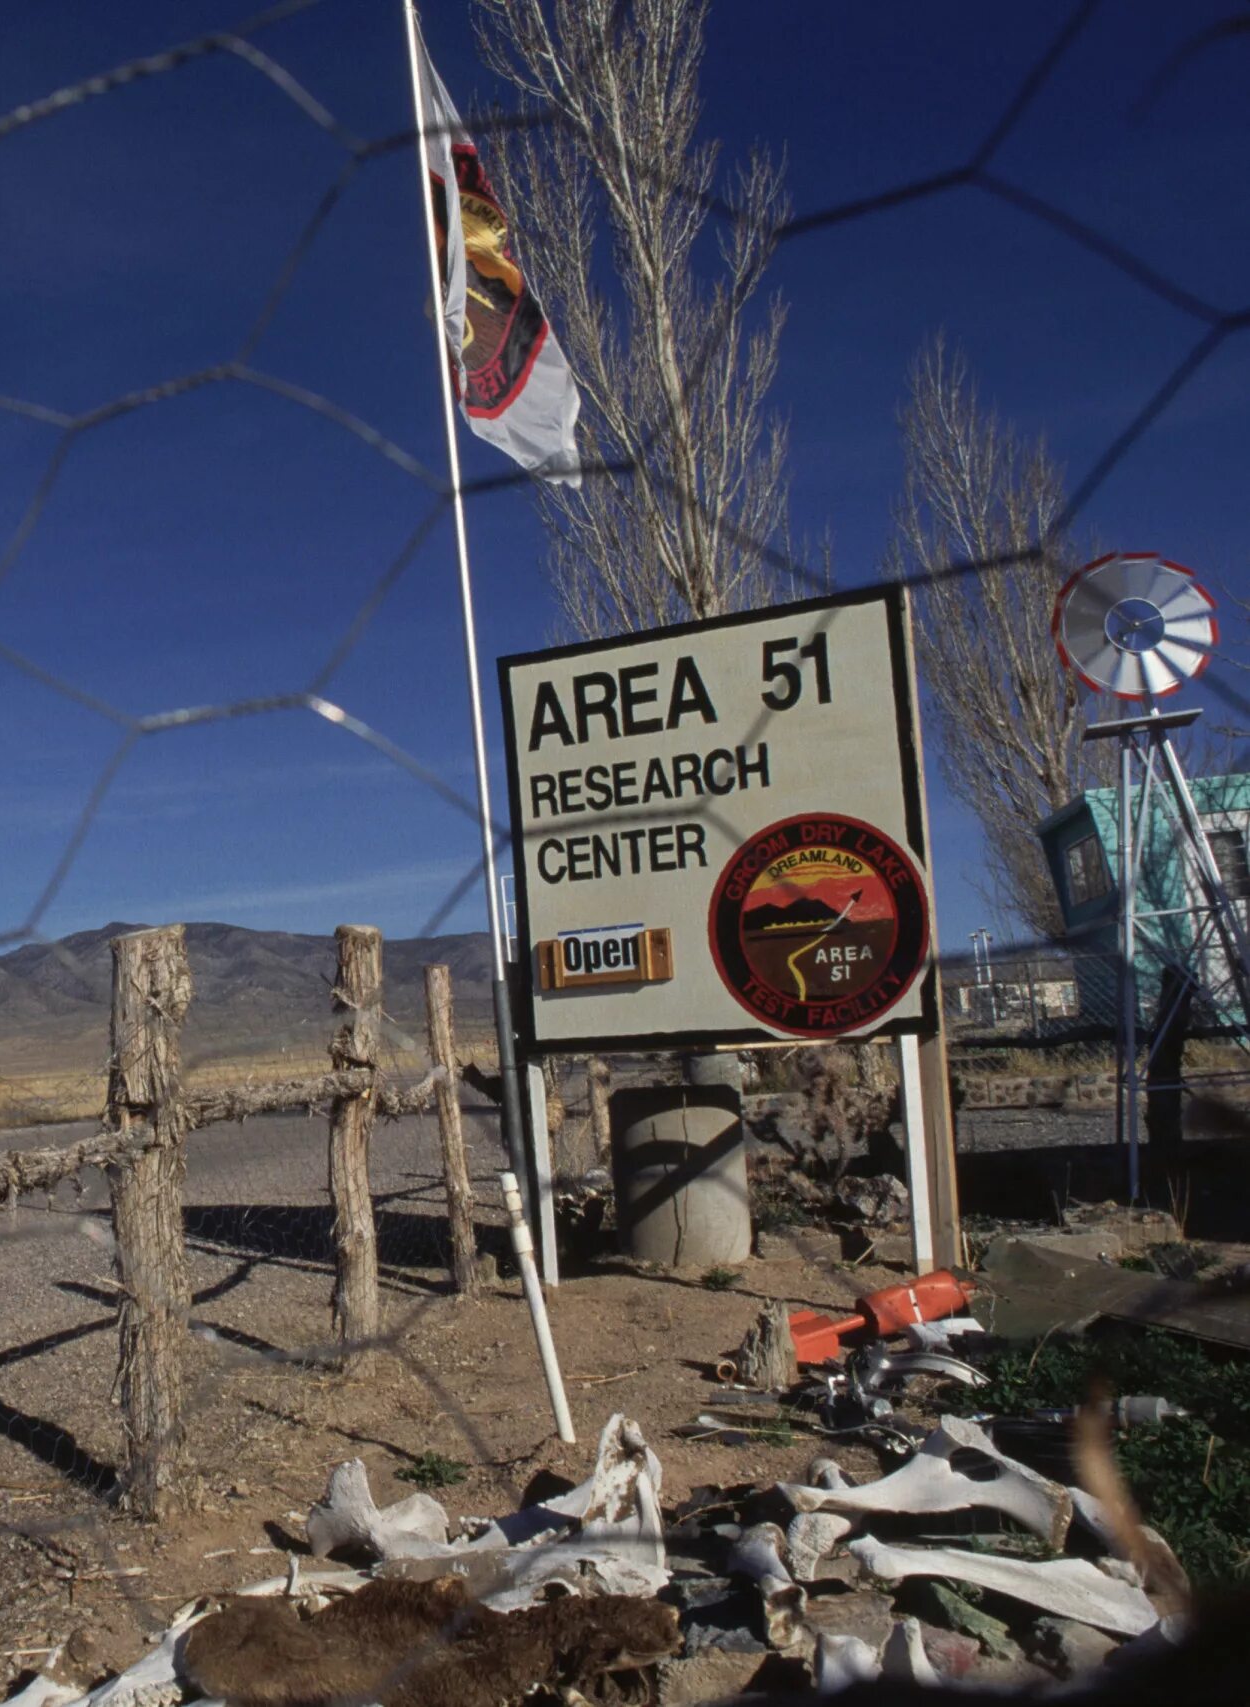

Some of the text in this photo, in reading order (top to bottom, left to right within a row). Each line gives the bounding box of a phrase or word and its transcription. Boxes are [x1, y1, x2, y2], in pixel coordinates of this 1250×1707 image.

[528, 631, 833, 752] AREA 51
[531, 742, 771, 818] RESEARCH
[537, 822, 708, 885] CENTER
[725, 824, 911, 901] GROOM DRY LAKE
[768, 849, 863, 878] DREAMLAND
[563, 936, 640, 973] Open
[814, 944, 874, 965] AREA
[830, 965, 851, 982] 51
[742, 974, 902, 1026] TEST FACILITY
